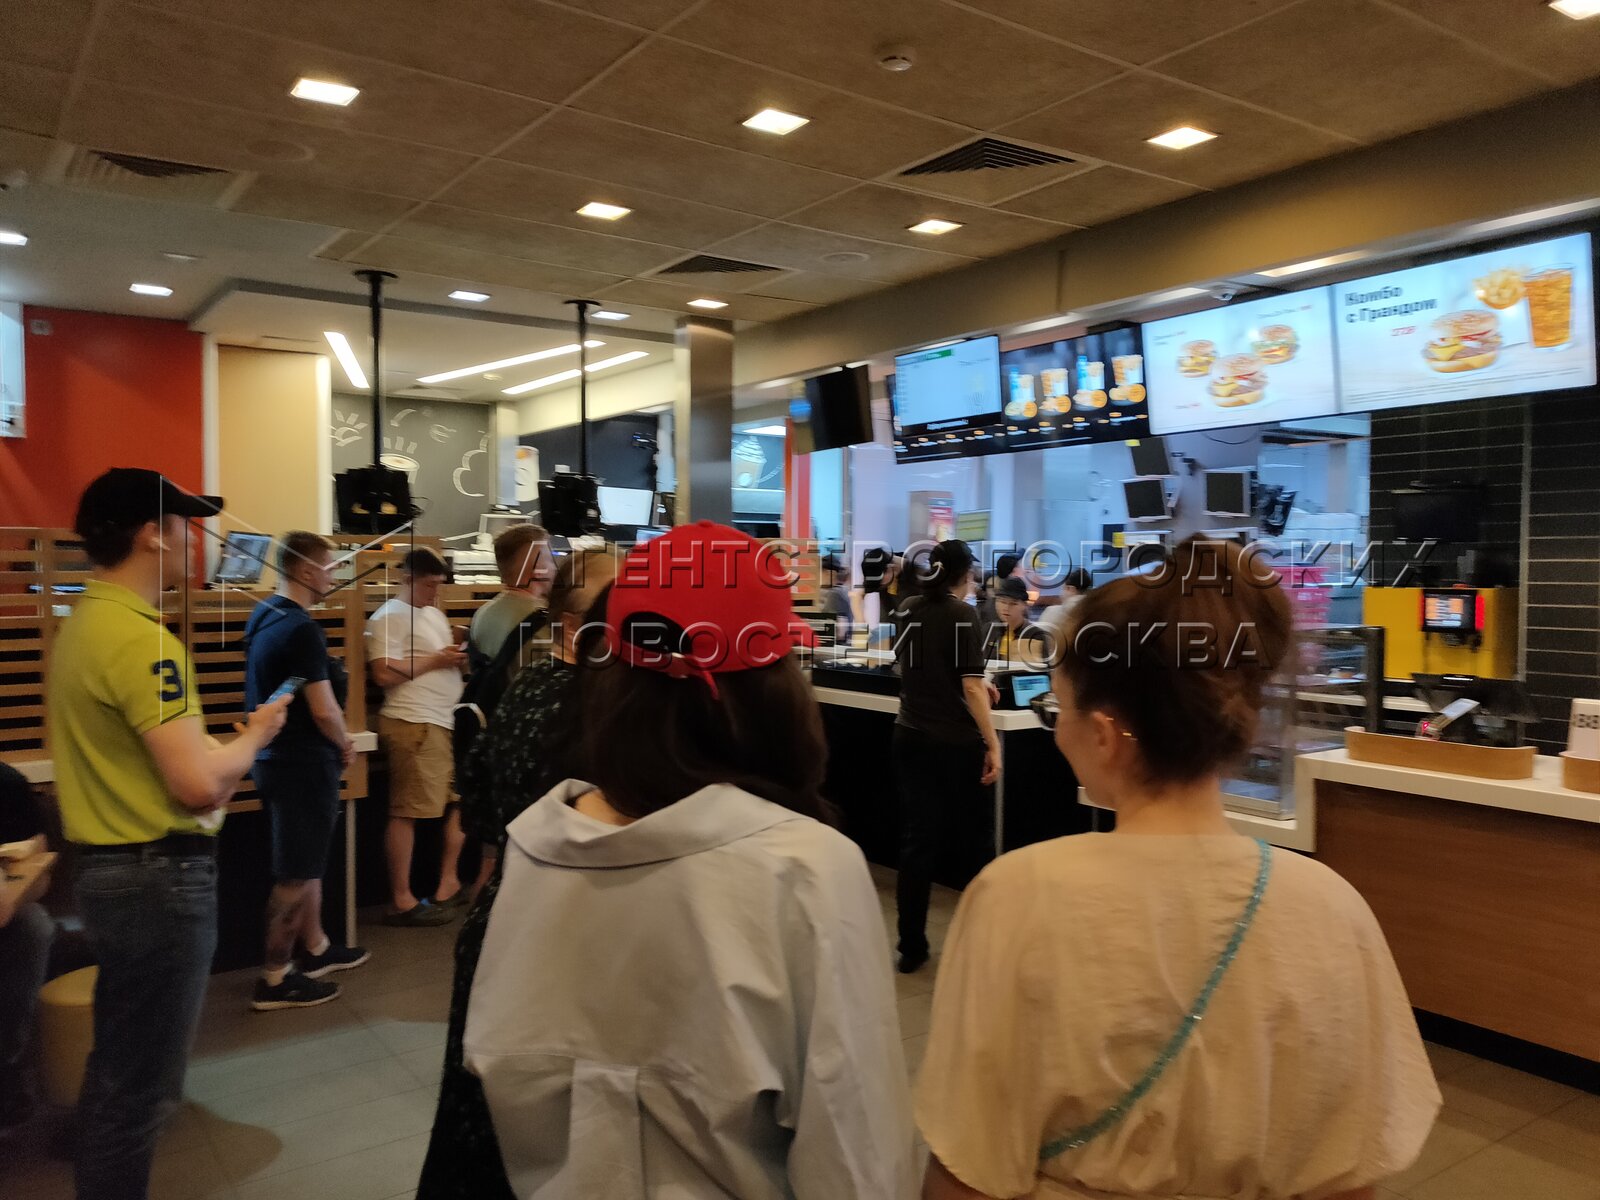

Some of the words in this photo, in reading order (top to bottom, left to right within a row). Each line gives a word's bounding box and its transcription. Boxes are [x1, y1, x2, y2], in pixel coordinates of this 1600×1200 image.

[1345, 286, 1402, 306] Комбо
[1346, 313, 1357, 323] с
[1359, 299, 1438, 322] Грандом
[152, 659, 184, 702] 3
